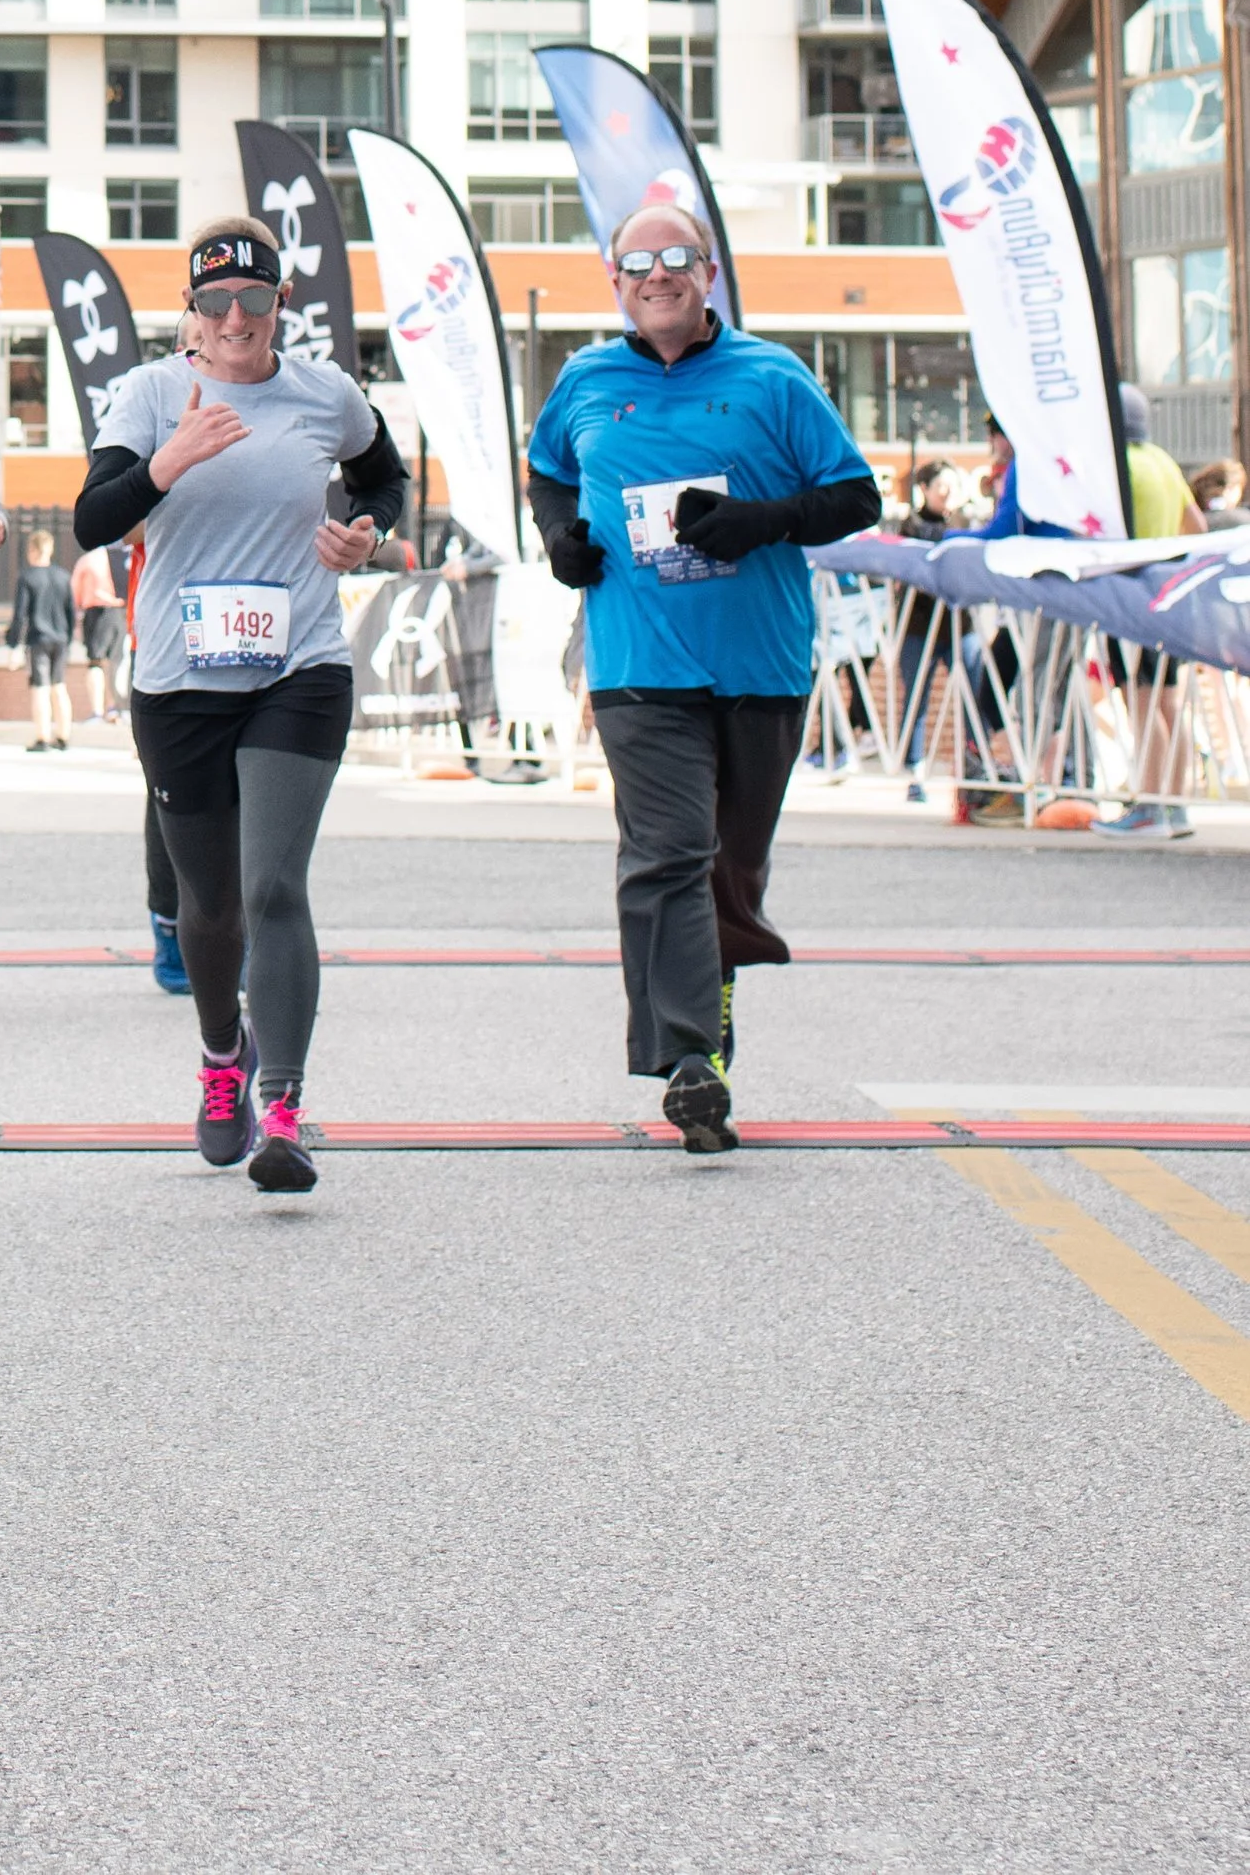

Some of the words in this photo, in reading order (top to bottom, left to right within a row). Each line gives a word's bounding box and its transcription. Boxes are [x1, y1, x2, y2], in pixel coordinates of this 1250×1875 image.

[186, 604, 196, 621] C
[221, 611, 273, 639] 1492
[237, 639, 257, 650] AMY
